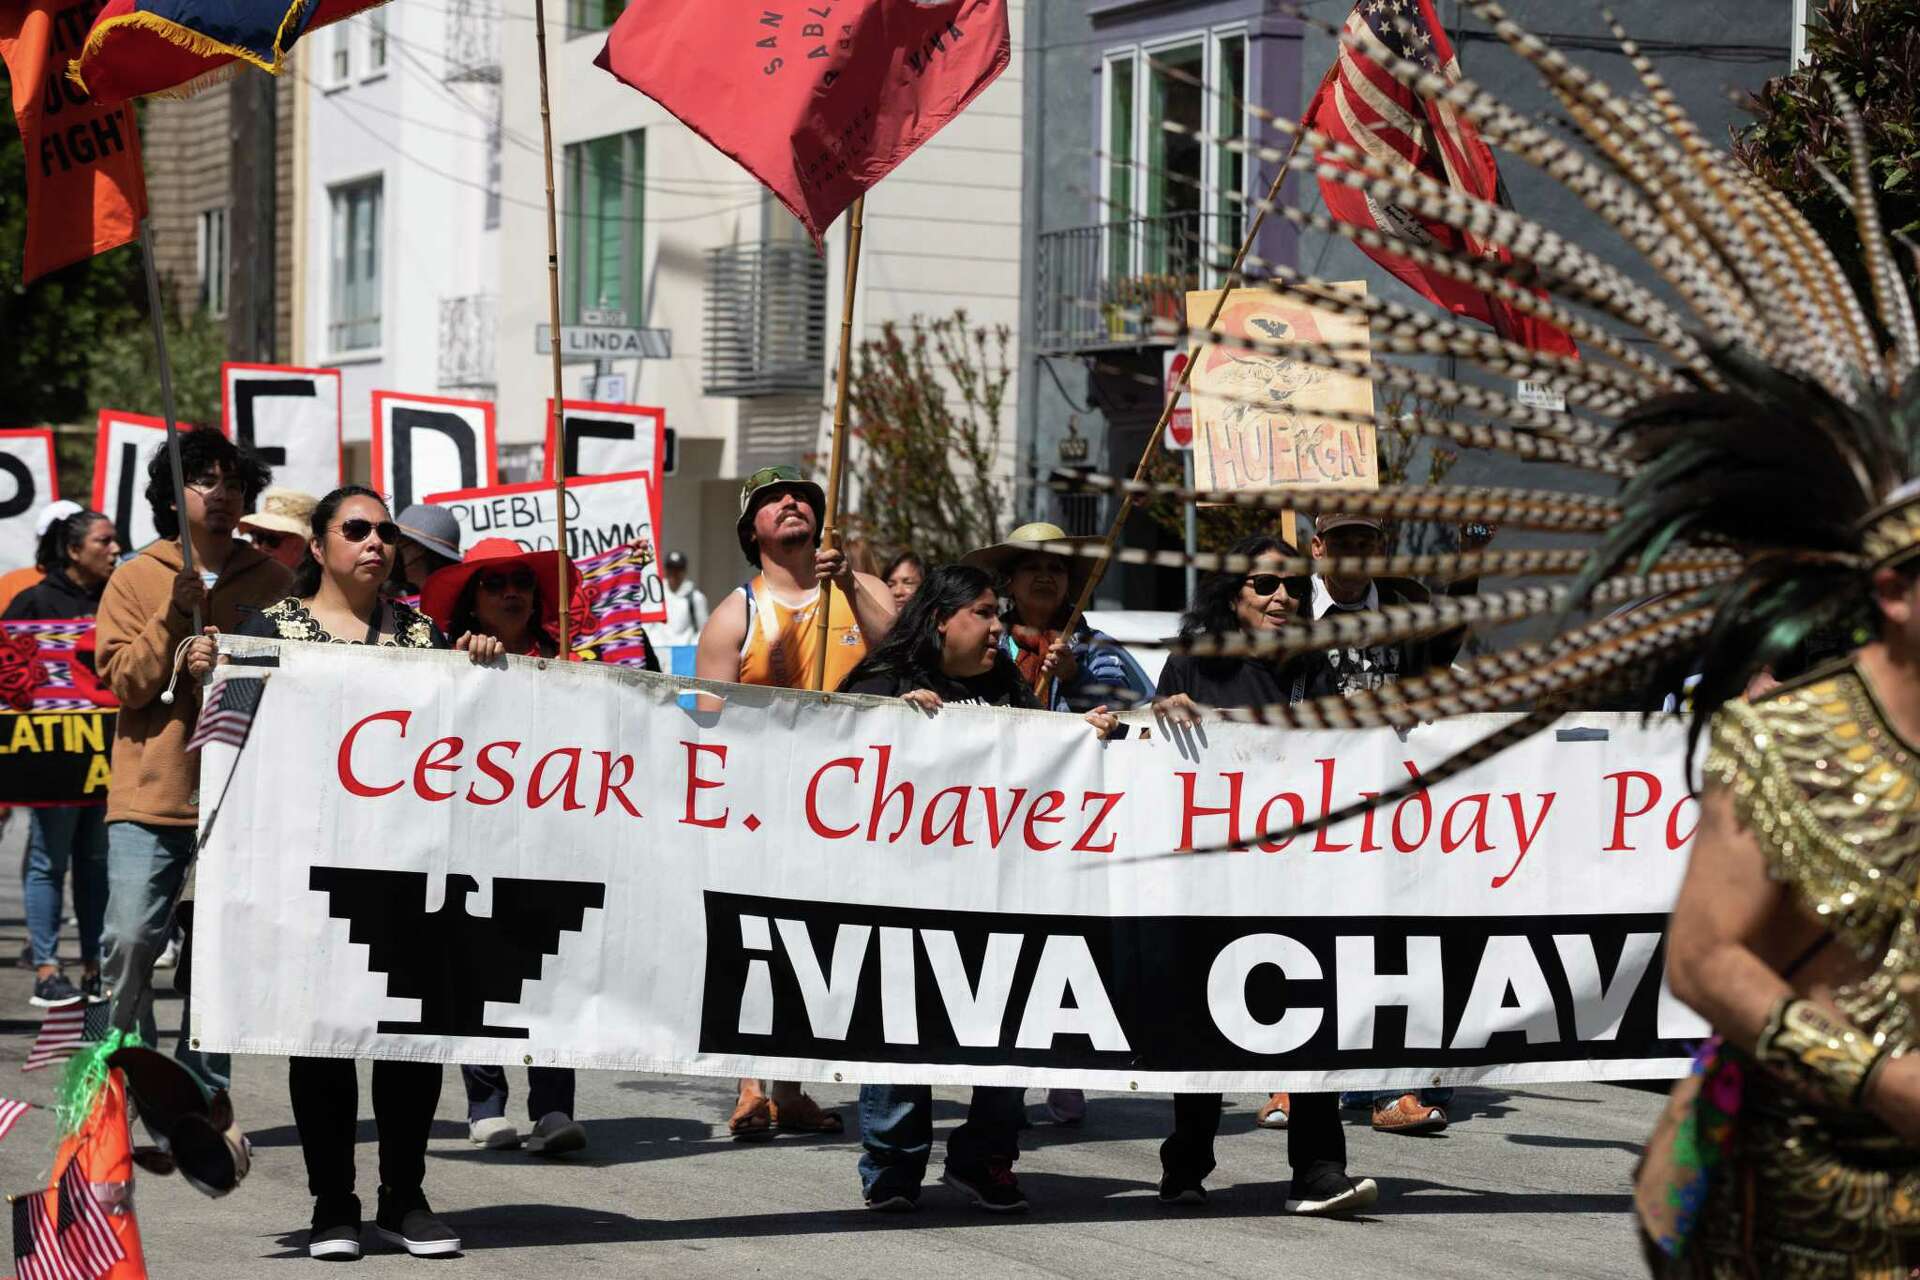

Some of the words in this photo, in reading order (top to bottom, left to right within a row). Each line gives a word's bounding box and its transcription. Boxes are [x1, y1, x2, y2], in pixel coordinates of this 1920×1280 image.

[756, 11, 784, 76] SAN
[570, 331, 639, 351] LINDA
[449, 489, 581, 532] PUEBLO
[0, 713, 105, 754] ATIN
[678, 740, 762, 833] E.
[805, 744, 1126, 853] Chavez
[1172, 757, 1557, 888] Holiday
[738, 914, 1132, 1052] ¡VIVA
